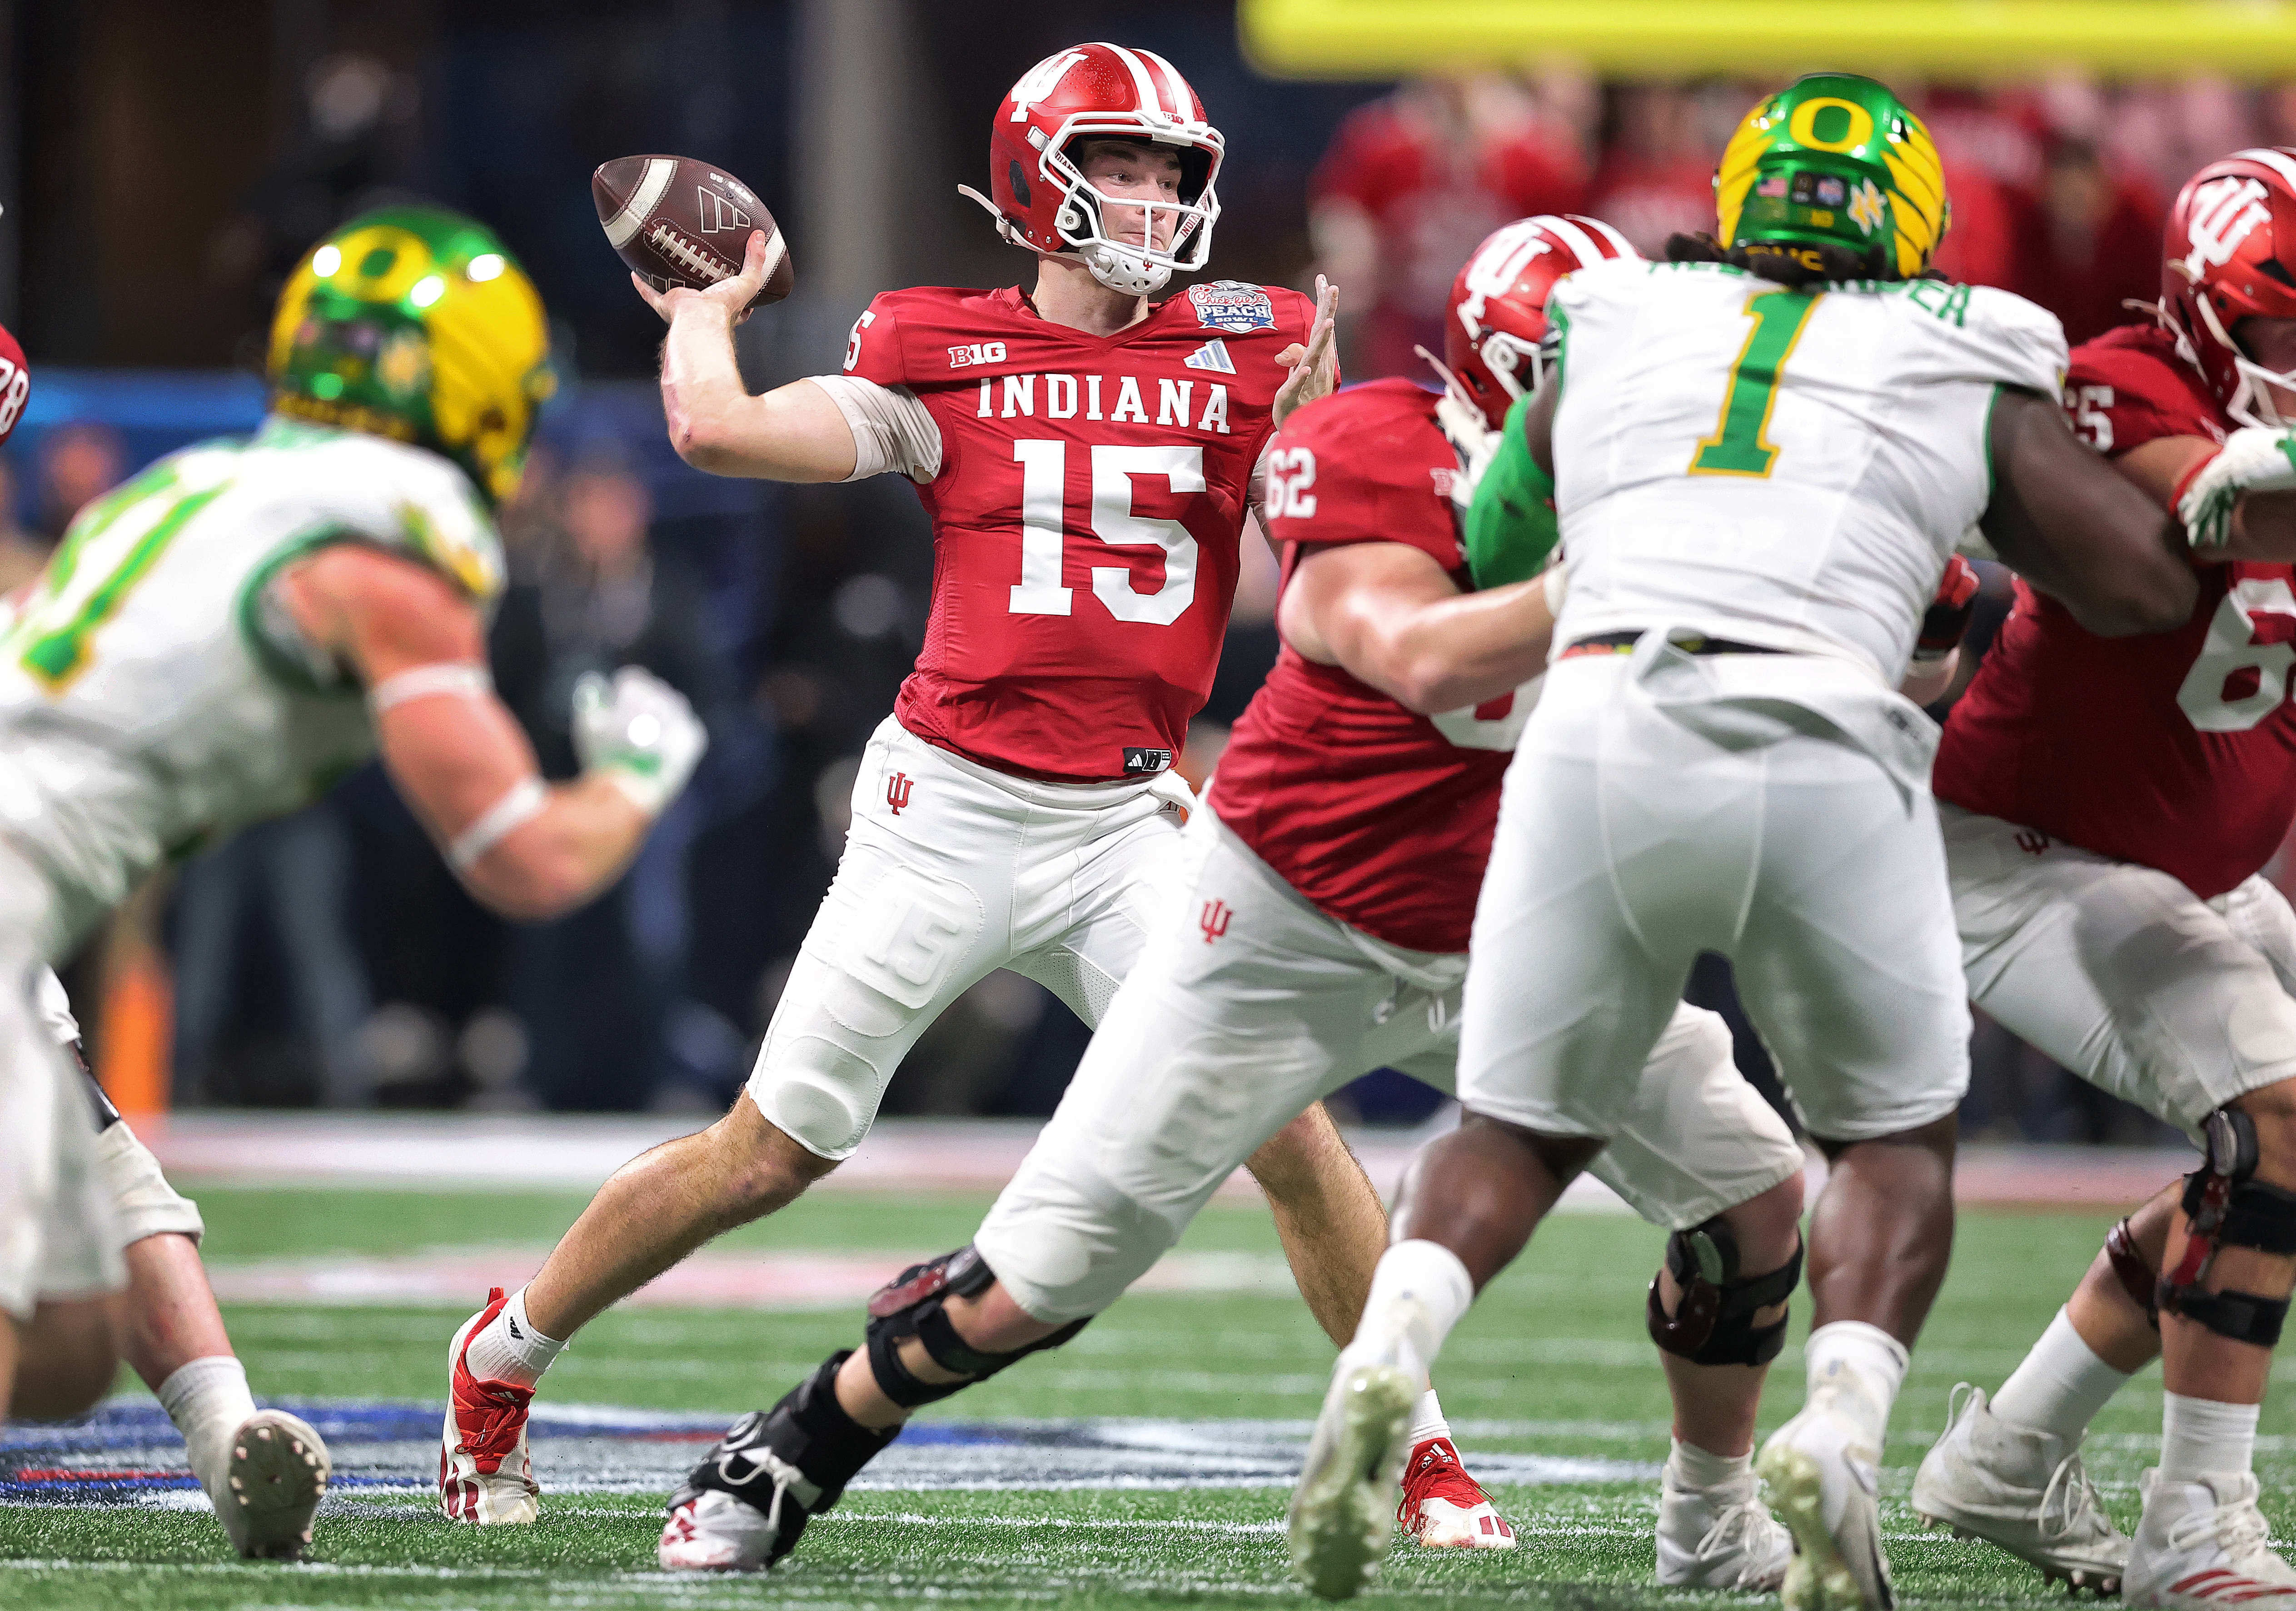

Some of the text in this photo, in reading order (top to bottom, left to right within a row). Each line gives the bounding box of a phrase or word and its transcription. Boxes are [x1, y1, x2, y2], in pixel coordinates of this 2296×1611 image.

[1790, 97, 1874, 153] O
[842, 310, 877, 372] 5
[1198, 305, 1269, 319] PEACH
[976, 373, 1230, 434] INDIANA
[1688, 286, 1824, 479] 1
[2062, 386, 2115, 451] 5
[1265, 447, 1317, 519] 62
[1008, 439, 1207, 626] 15
[2176, 578, 2296, 733] 6
